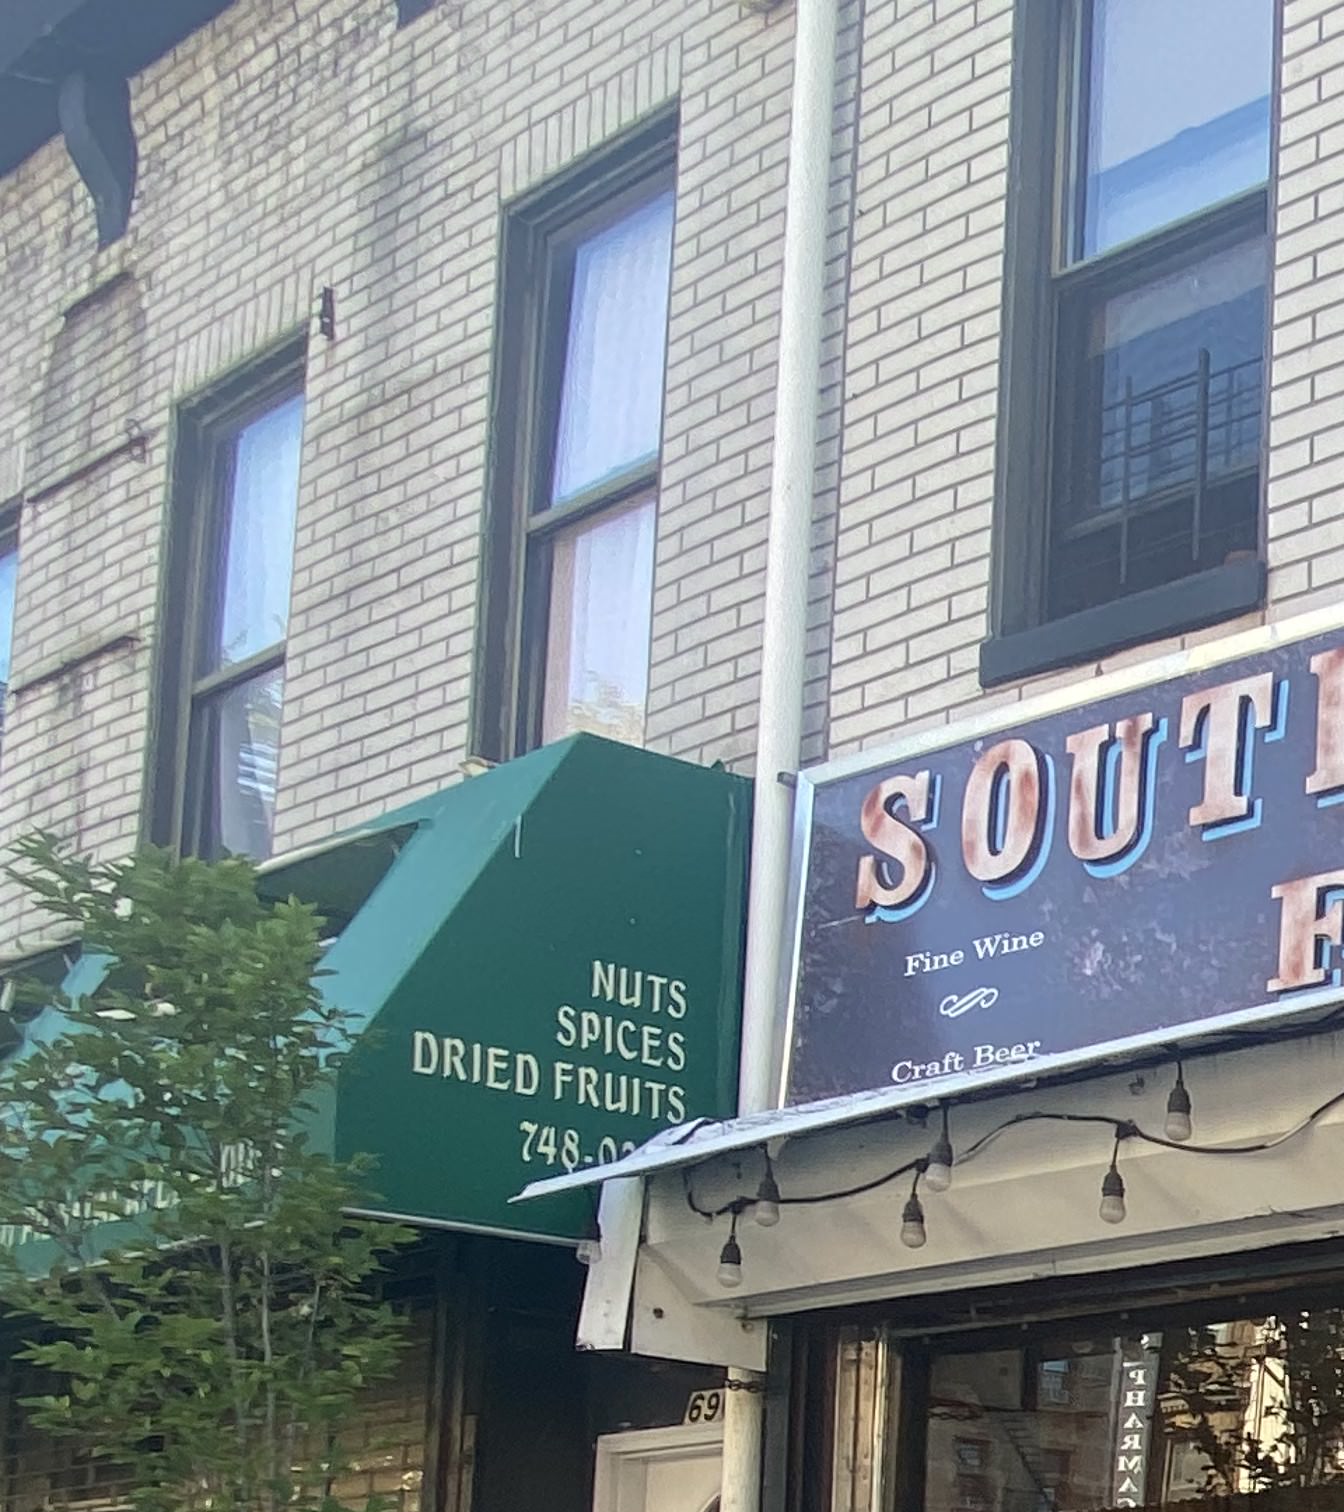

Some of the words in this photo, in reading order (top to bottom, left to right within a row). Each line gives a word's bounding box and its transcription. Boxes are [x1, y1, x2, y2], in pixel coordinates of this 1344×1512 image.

[903, 949, 964, 977] Fine
[971, 930, 1044, 959] Wine
[591, 961, 687, 1019] NUTS
[557, 1006, 686, 1071] SPICES
[891, 1050, 967, 1084] Craft
[973, 1037, 1041, 1071] Beer
[413, 1032, 539, 1096] DRIED
[554, 1061, 686, 1124] FRUITS
